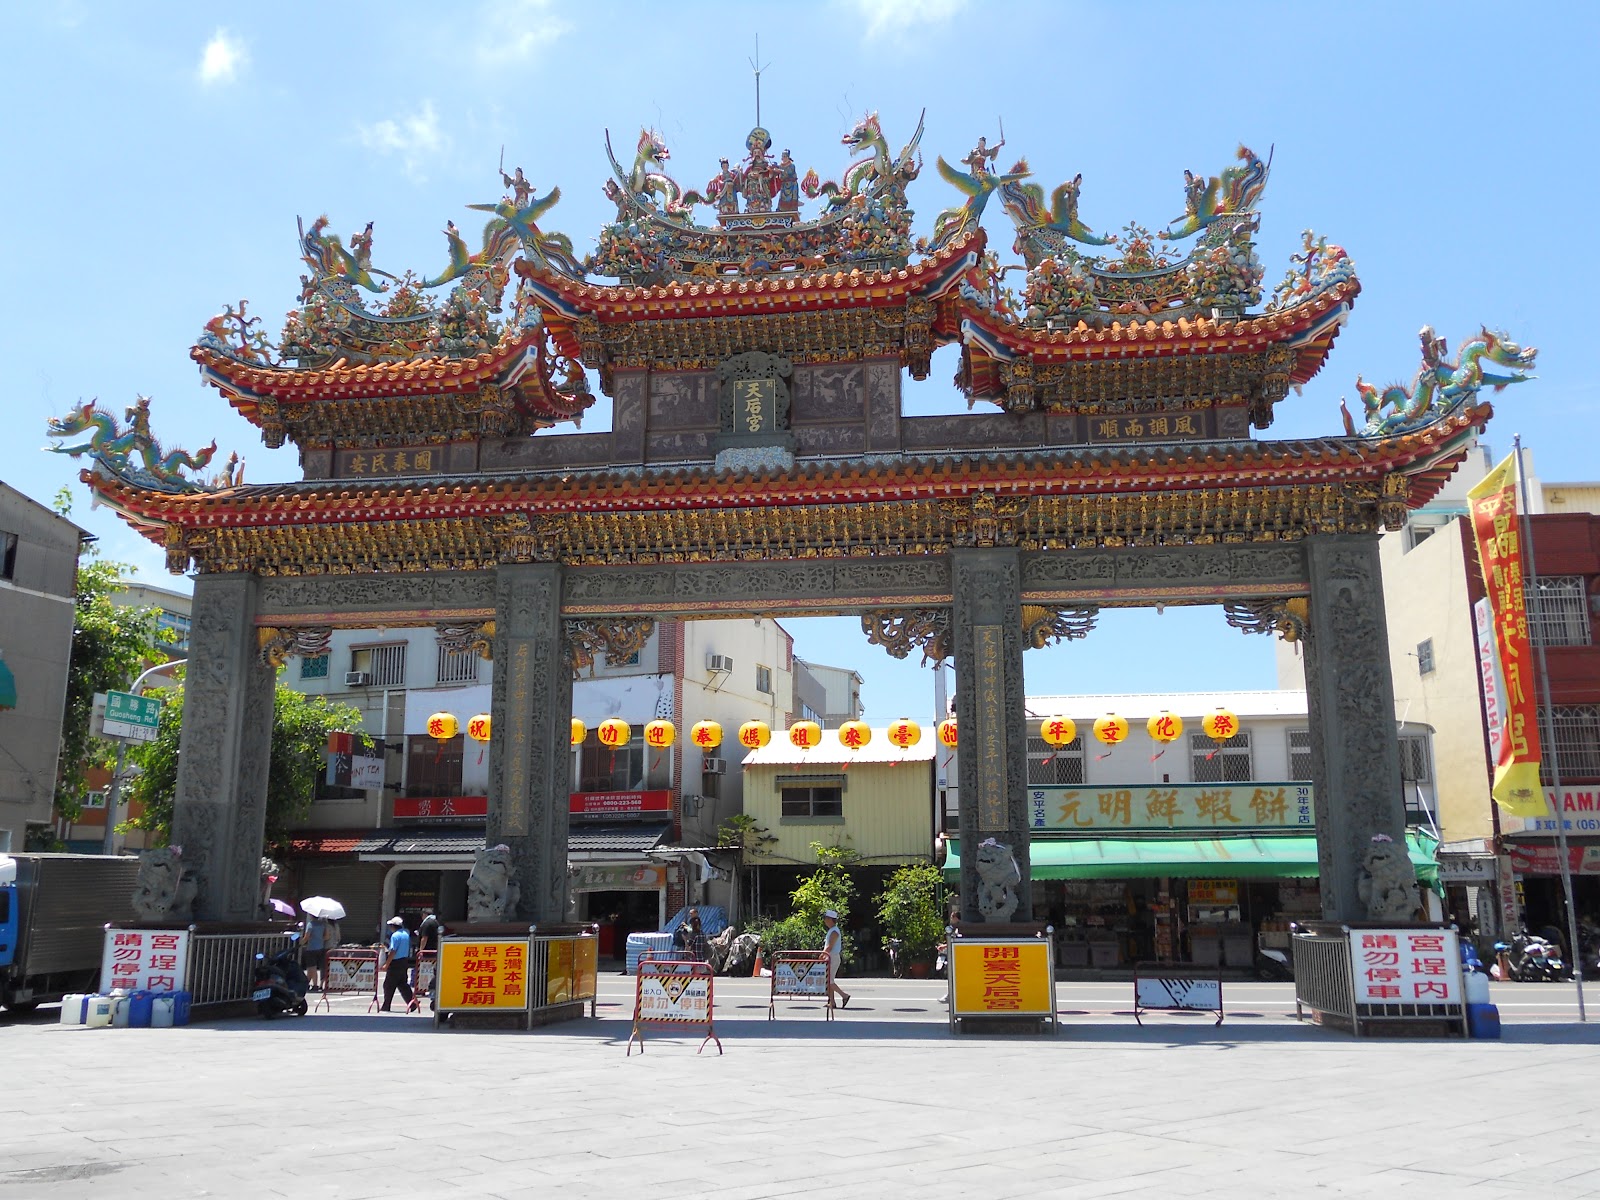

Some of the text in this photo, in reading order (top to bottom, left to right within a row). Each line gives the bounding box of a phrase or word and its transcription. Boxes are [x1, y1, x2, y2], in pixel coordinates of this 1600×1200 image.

[745, 382, 763, 432] 天后宮
[110, 710, 141, 722] Guosheng
[111, 695, 155, 714] 國勝路
[1481, 641, 1500, 745] YAMAHA
[1033, 791, 1045, 826] 安平名產
[1056, 786, 1290, 826] 元明鮮蝦餅
[110, 933, 142, 989] 請勿停車
[147, 934, 180, 991] 宮埕內
[461, 959, 497, 1005] 媽祖廟
[503, 946, 522, 996] 台灣本島
[983, 946, 1023, 1010] 開臺天后宮
[1362, 934, 1402, 999] 請勿停車
[1407, 935, 1449, 999] 宮埕內
[643, 988, 663, 996] 出入口
